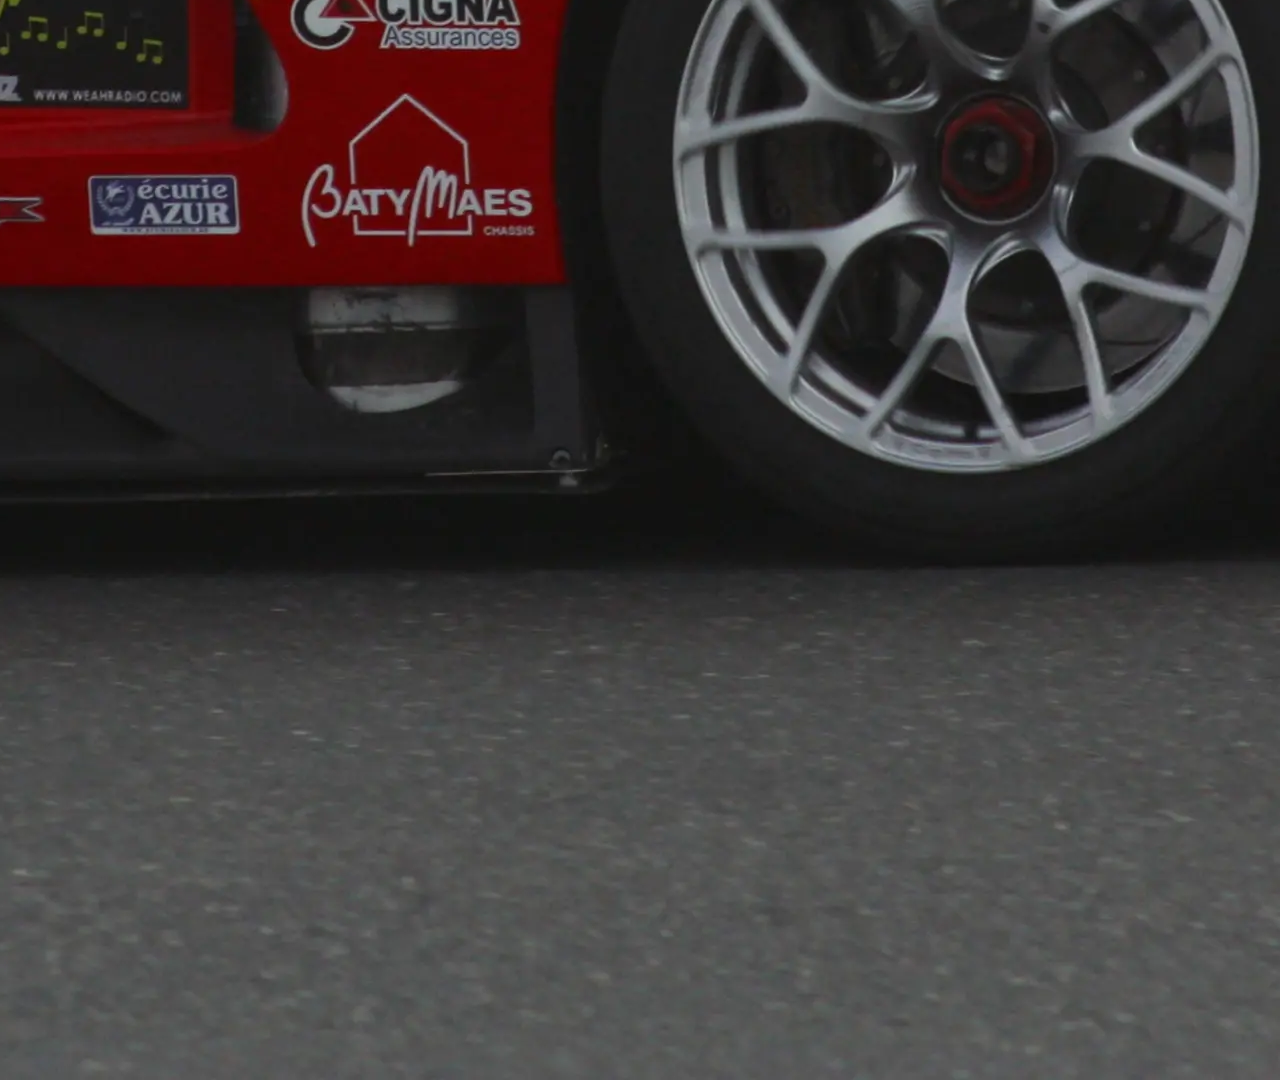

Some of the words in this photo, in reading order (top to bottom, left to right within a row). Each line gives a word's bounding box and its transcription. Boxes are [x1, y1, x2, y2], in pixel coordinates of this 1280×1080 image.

[381, 25, 520, 48] Assurances
[137, 178, 228, 200] écurie
[138, 201, 231, 225] AZUR
[483, 225, 535, 237] CHASSIS
